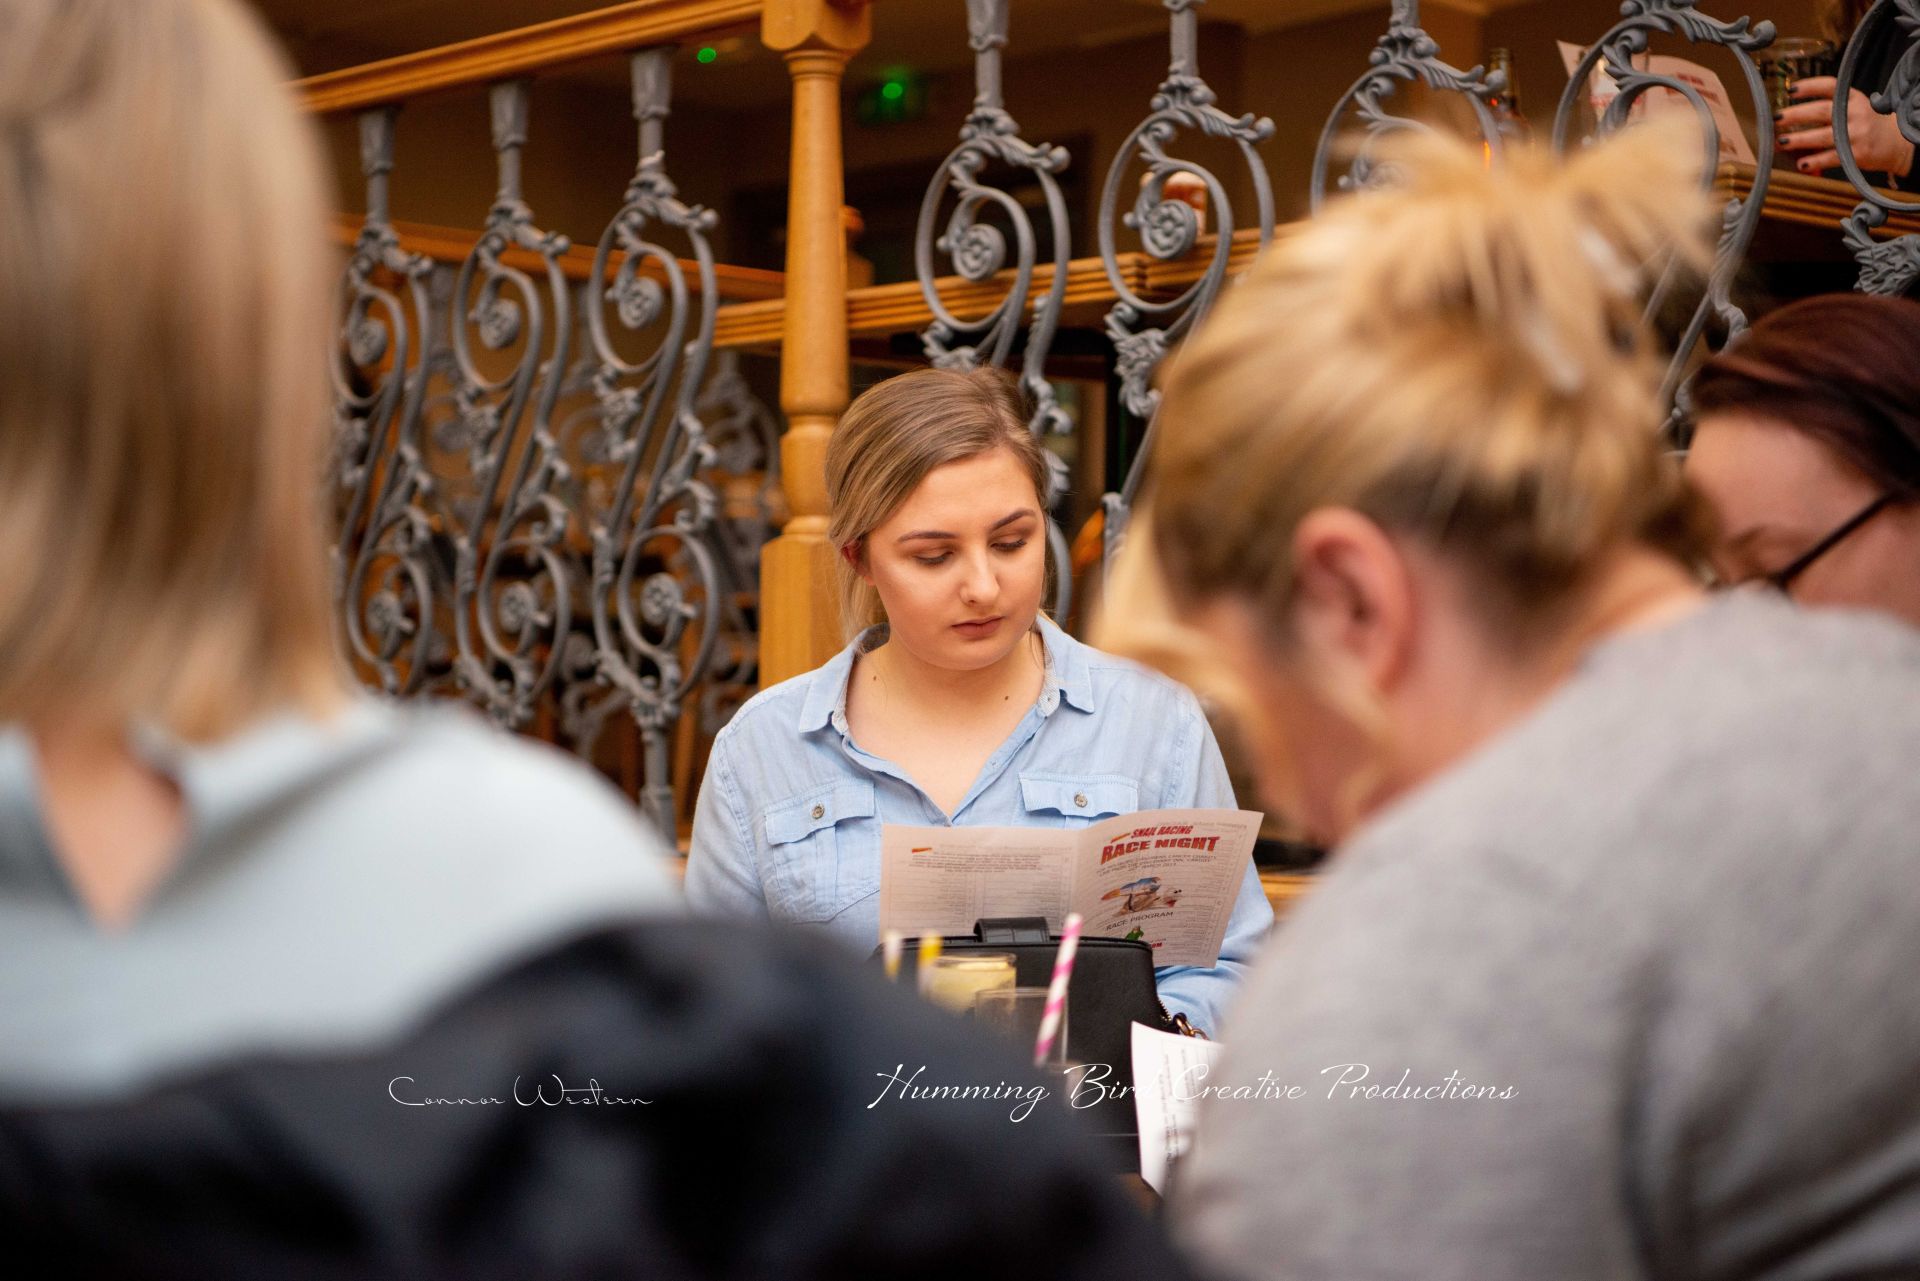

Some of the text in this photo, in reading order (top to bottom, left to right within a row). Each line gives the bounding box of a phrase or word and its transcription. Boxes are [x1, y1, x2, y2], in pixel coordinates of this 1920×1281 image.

[1131, 827, 1157, 839] SNAIL
[1157, 825, 1193, 836] RACING
[1101, 836, 1221, 865] RACE NIGHT
[1106, 911, 1174, 931] RACE PROGRAM
